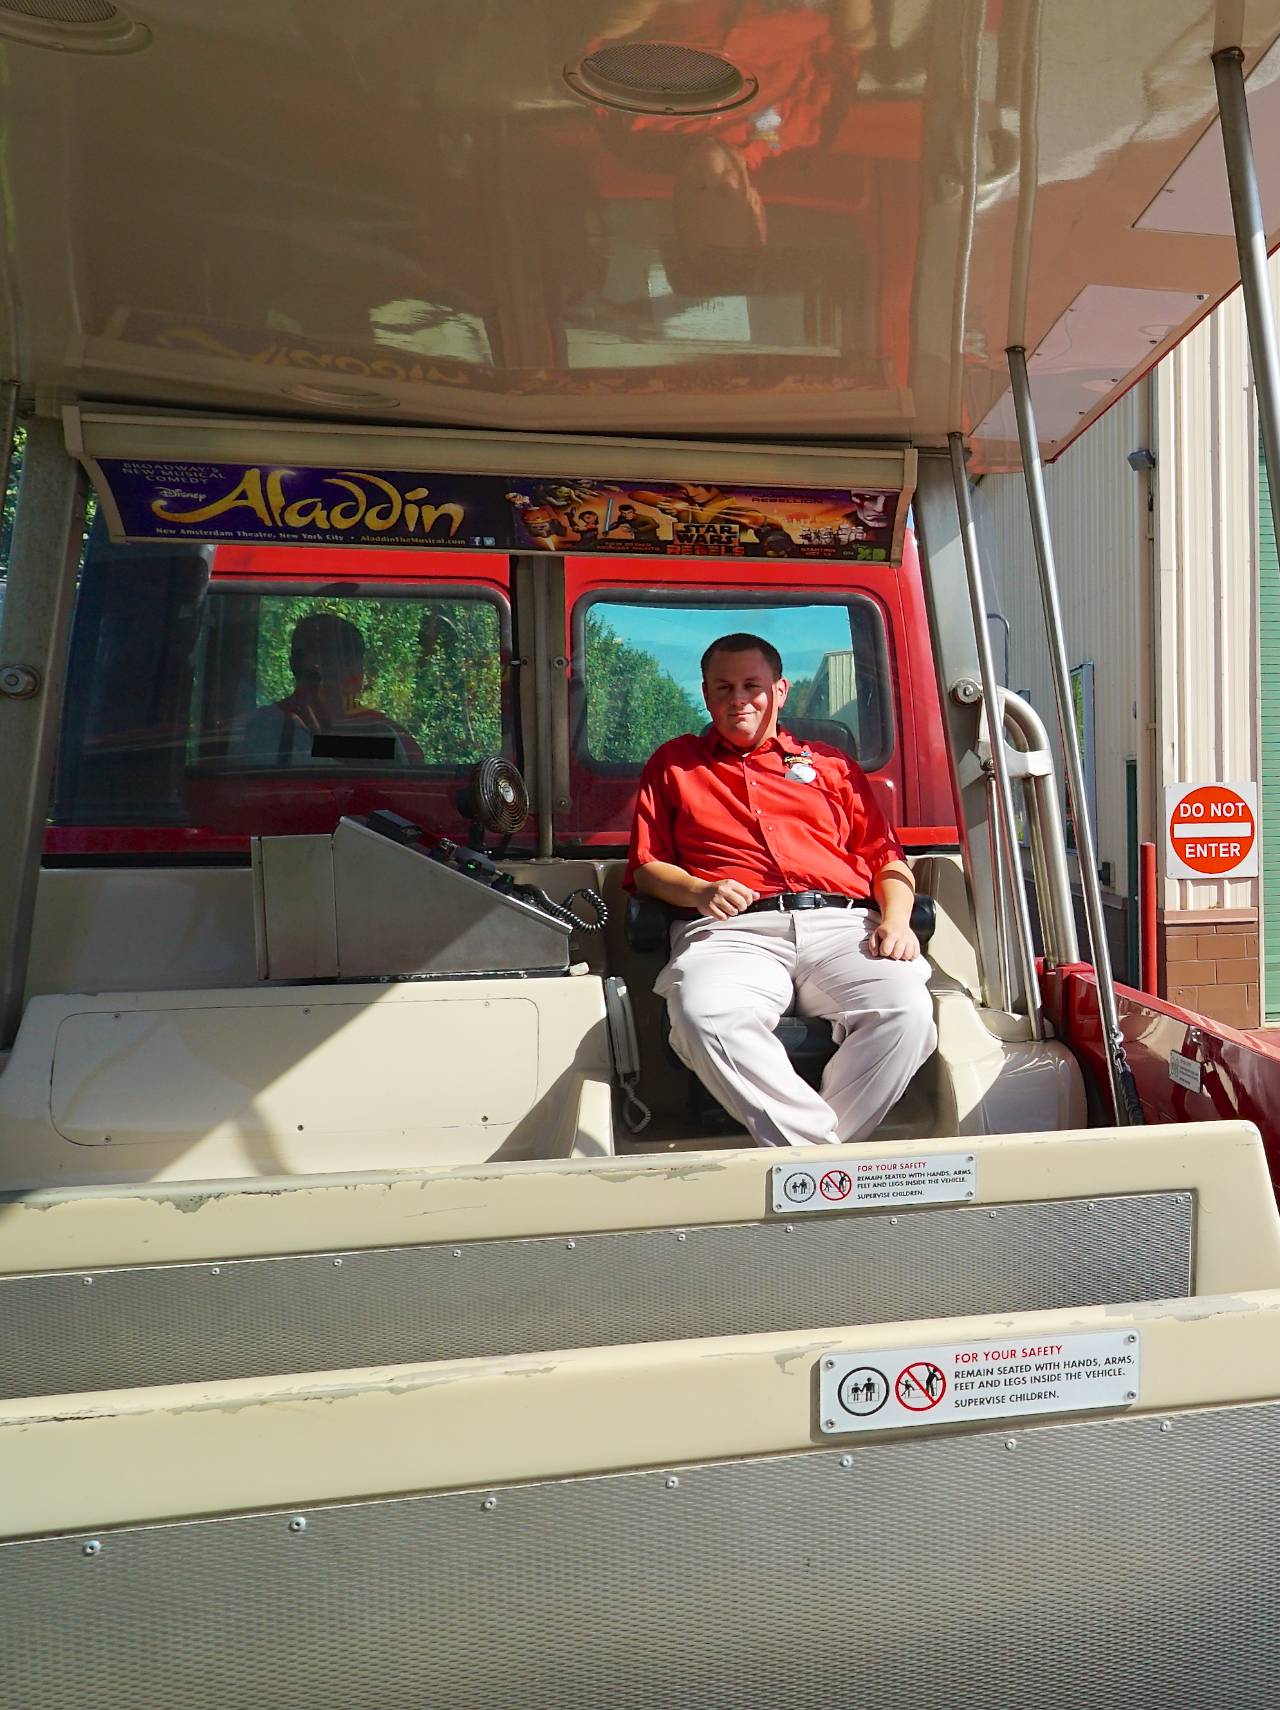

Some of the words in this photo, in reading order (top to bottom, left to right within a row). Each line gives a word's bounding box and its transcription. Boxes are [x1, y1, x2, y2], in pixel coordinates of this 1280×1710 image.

[145, 475, 209, 484] COMEDY
[160, 470, 227, 479] MUSICAL
[155, 486, 207, 502] Disney
[151, 468, 465, 537] Aladdin
[156, 527, 177, 536] New
[180, 528, 234, 538] Amsterdam
[325, 534, 345, 542] City
[676, 523, 739, 535] STAR
[676, 533, 739, 545] WARS
[666, 544, 745, 556] REBELS
[1179, 803, 1205, 818] DO
[1210, 802, 1245, 817] NOT
[1185, 842, 1241, 858] ENTER
[900, 1162, 927, 1170] SAFETY
[858, 1192, 890, 1200] SUPERVISE
[955, 1353, 978, 1364] FOR
[983, 1350, 1017, 1361] YOUR
[1022, 1345, 1063, 1358] SAFETY
[955, 1368, 994, 1379] REMAIN
[998, 1365, 1032, 1375] SEATED
[1035, 1362, 1060, 1372] WITH
[1064, 1358, 1101, 1369] HANDS,
[1104, 1355, 1135, 1365] ARMS,
[955, 1382, 975, 1391] FEET
[979, 1380, 1000, 1389] AND
[1004, 1377, 1027, 1387] LEGS
[1031, 1374, 1061, 1384] INSIDE
[1065, 1371, 1082, 1380] THE
[1085, 1368, 1126, 1379] VEHICLE.
[955, 1395, 1006, 1408] SUPERVISE
[1009, 1391, 1059, 1403] CHILDREN.
